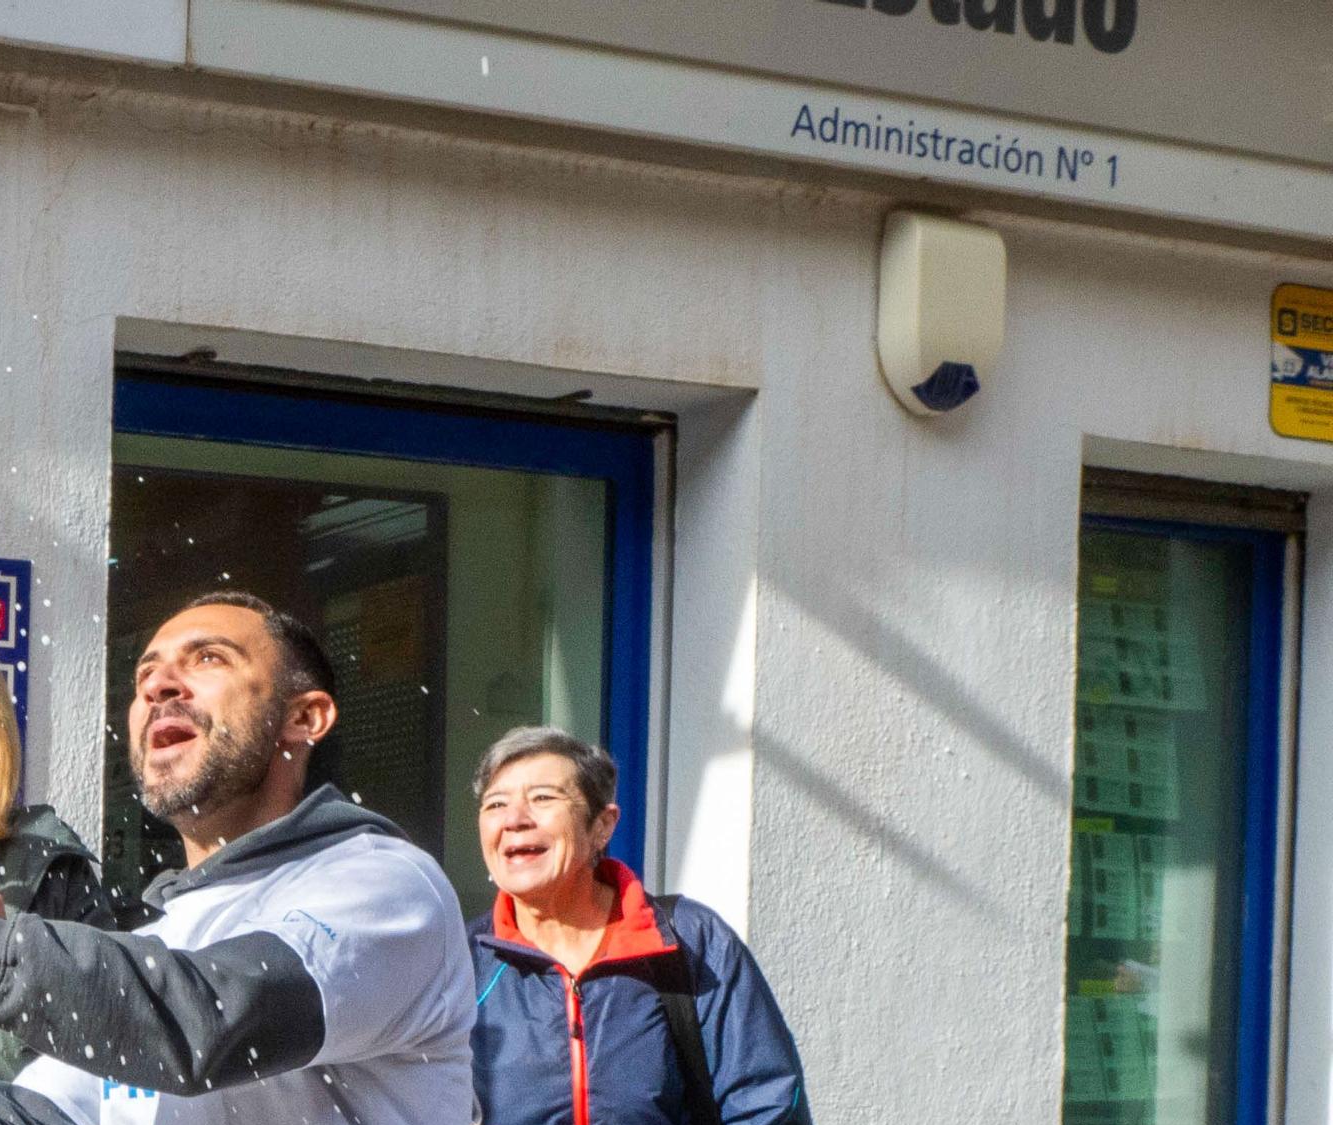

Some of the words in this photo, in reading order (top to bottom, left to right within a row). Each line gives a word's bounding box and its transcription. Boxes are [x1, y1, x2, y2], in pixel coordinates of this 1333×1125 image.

[790, 104, 1044, 177] Administración
[1056, 147, 1094, 182] Nº
[1105, 155, 1119, 188] 1
